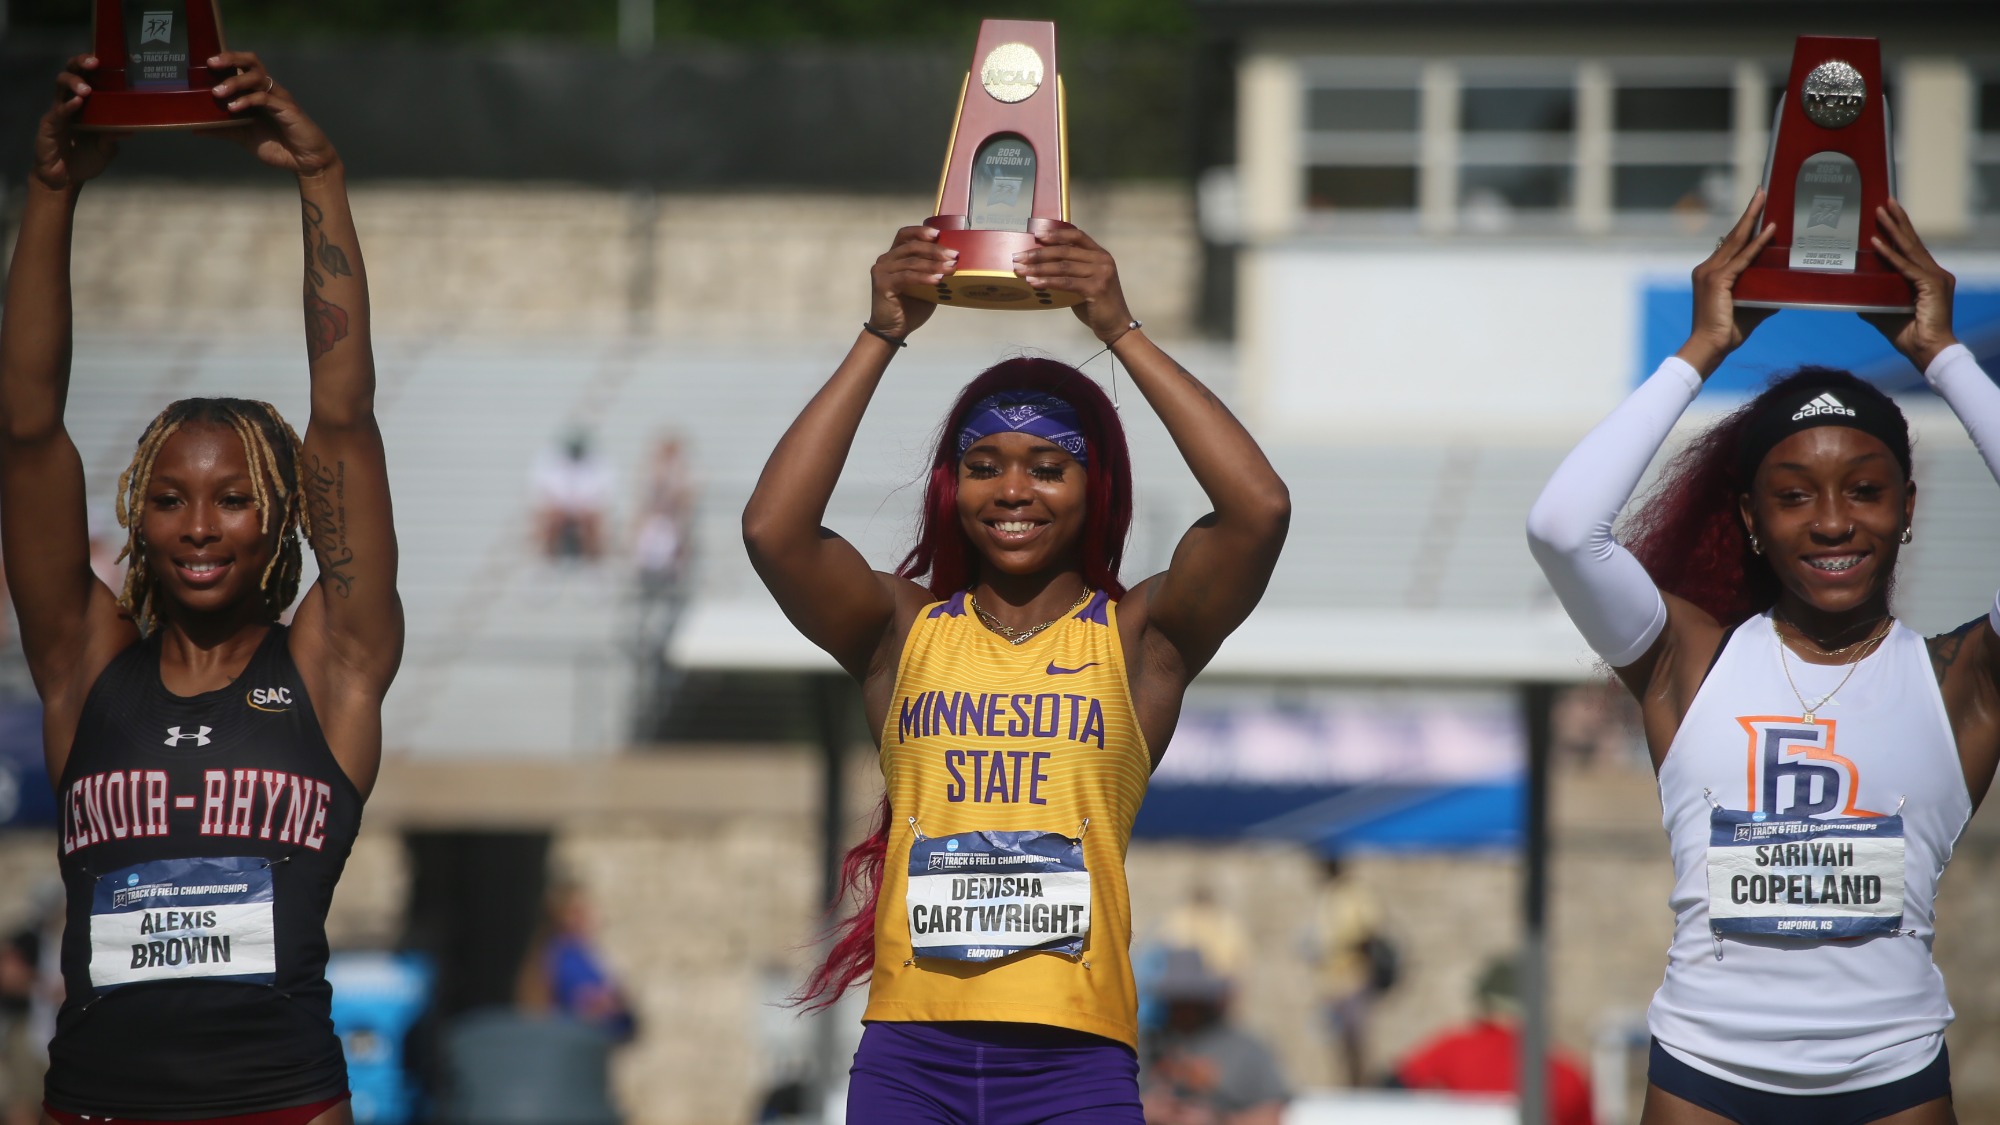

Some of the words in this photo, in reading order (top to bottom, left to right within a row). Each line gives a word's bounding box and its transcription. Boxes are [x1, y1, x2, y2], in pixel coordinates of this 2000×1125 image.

[143, 54, 163, 62] TRACK
[985, 70, 1040, 86] NCAA
[985, 156, 1023, 166] DIVISION
[997, 148, 1021, 157] 2024
[1804, 172, 1843, 183] DIVISION
[1792, 405, 1856, 421] adidas
[253, 687, 293, 705] SAC
[899, 690, 1105, 750] MINNESOTA
[944, 750, 1051, 805] STATE
[64, 768, 332, 856] LENOIR-RHYNE
[1753, 826, 1778, 836] TRACK
[1778, 825, 1784, 833] &
[1785, 824, 1808, 834] FIELD
[944, 857, 968, 866] TRACK
[969, 857, 975, 866] &
[976, 856, 996, 865] FIELD
[1755, 842, 1853, 867] SARIYAH
[127, 889, 149, 901] TRACK
[150, 888, 157, 897] &
[157, 886, 179, 897] FIELD
[180, 883, 248, 896] CHAMPIONSHIPS
[951, 877, 1044, 901] DENISHA
[1730, 874, 1881, 905] COPELAND
[140, 910, 217, 936] ALEXIS
[912, 903, 1084, 934] CARTWRIGHT
[1777, 921, 1818, 930] EMPORIA,
[1820, 921, 1833, 930] KS
[130, 935, 231, 970] BROWN
[966, 948, 1004, 958] EMPORIA
